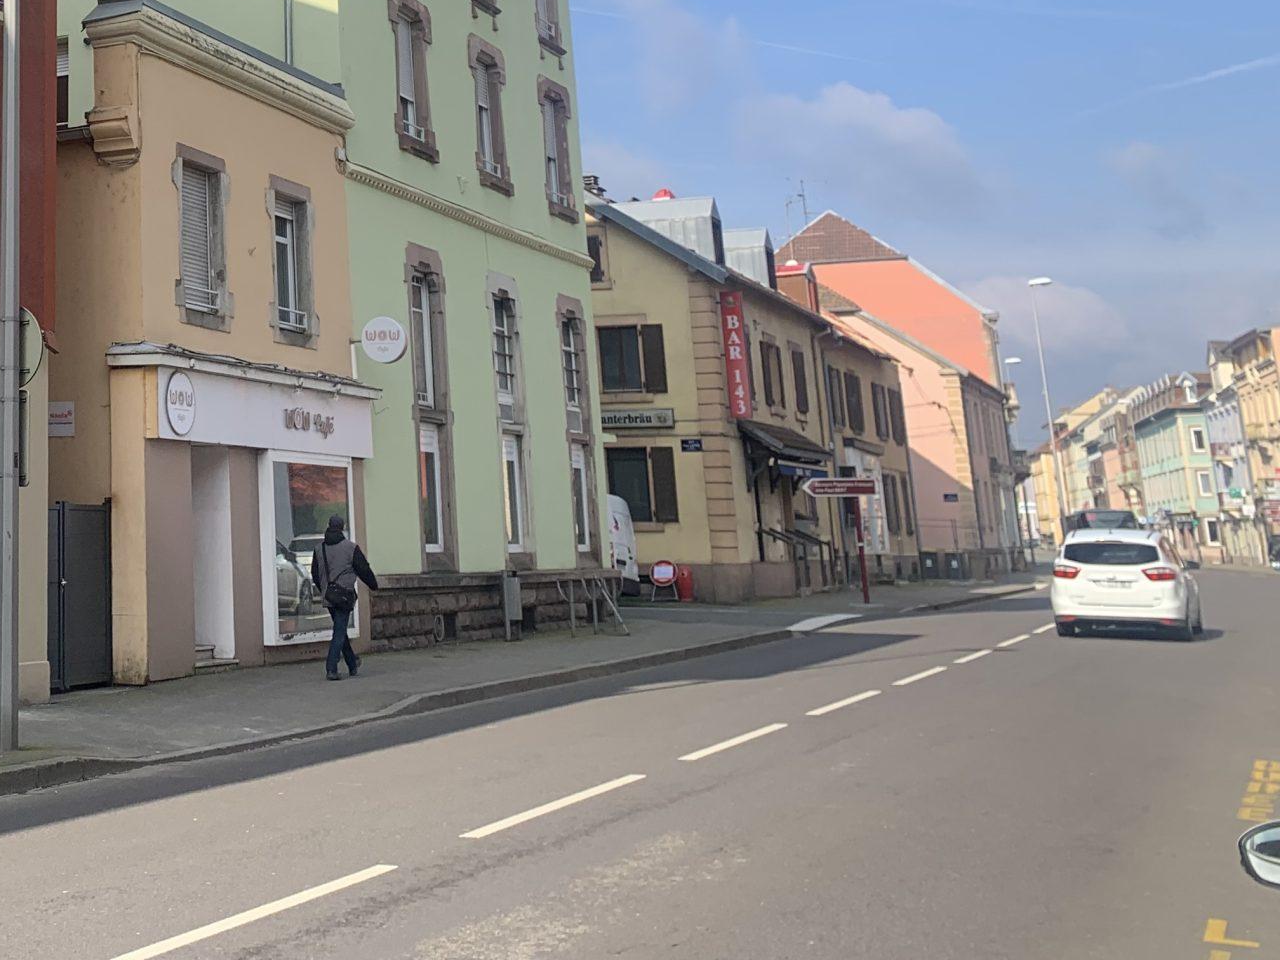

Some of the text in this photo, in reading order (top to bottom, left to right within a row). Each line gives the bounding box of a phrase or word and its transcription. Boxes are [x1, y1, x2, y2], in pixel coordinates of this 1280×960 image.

[365, 330, 401, 341] WOW
[726, 315, 746, 415] BAR 143
[170, 390, 193, 408] WOW
[284, 407, 311, 432] WOW
[601, 413, 652, 424] anterbräu
